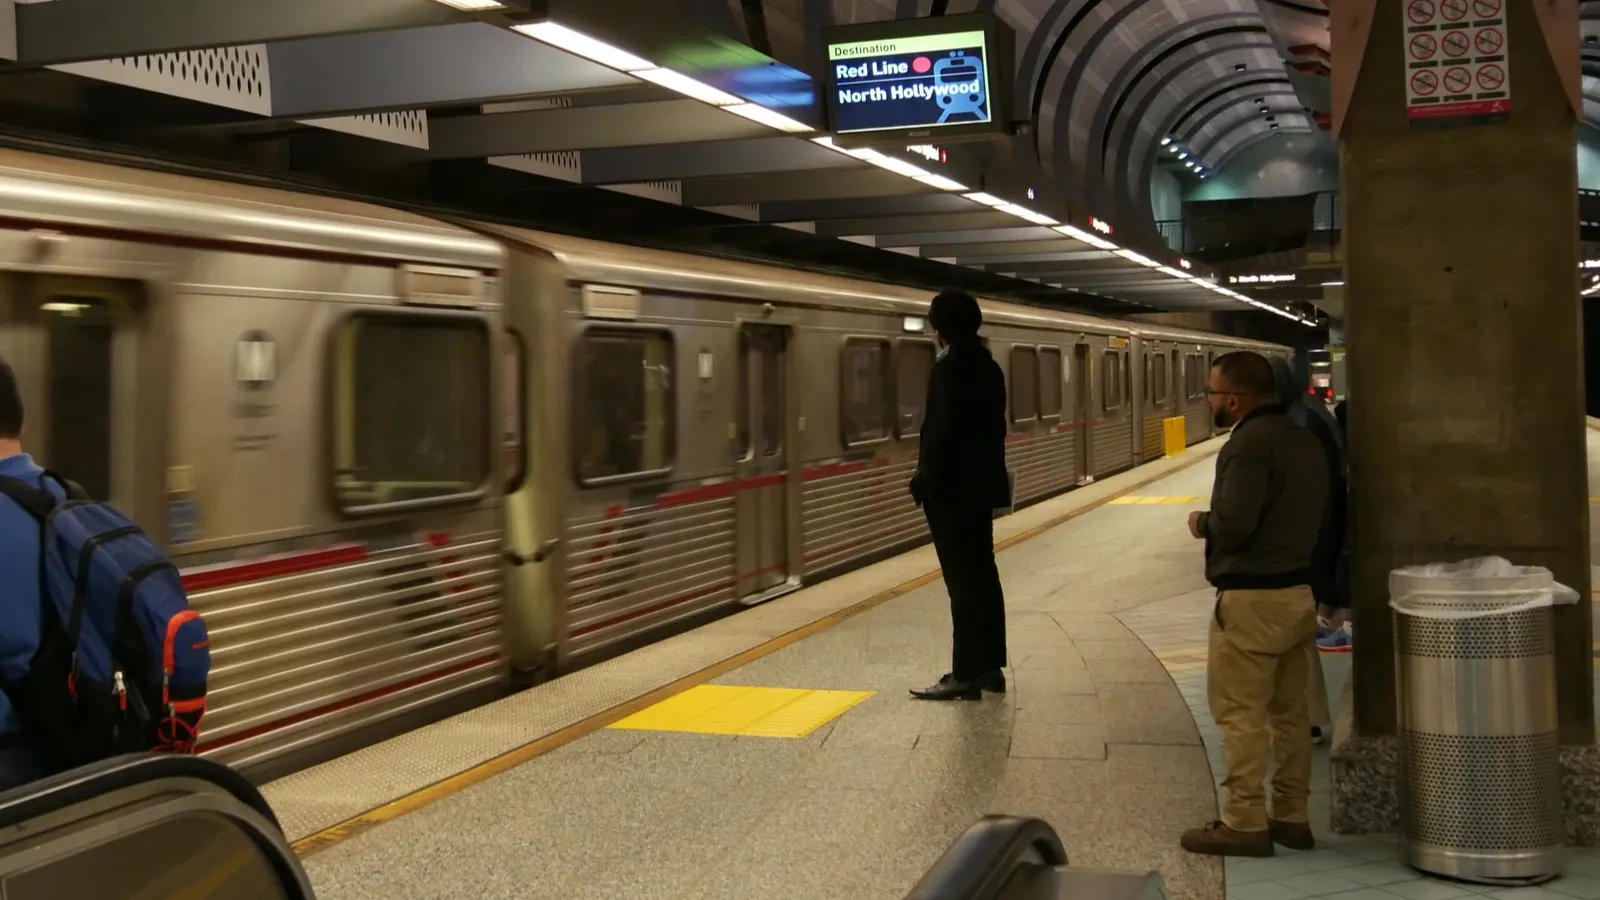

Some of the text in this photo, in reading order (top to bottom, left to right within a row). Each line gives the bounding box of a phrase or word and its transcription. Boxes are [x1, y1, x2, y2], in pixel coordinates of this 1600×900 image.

[834, 43, 896, 57] Destination
[836, 61, 908, 79] Red Line
[838, 79, 980, 104] North Hollywood
